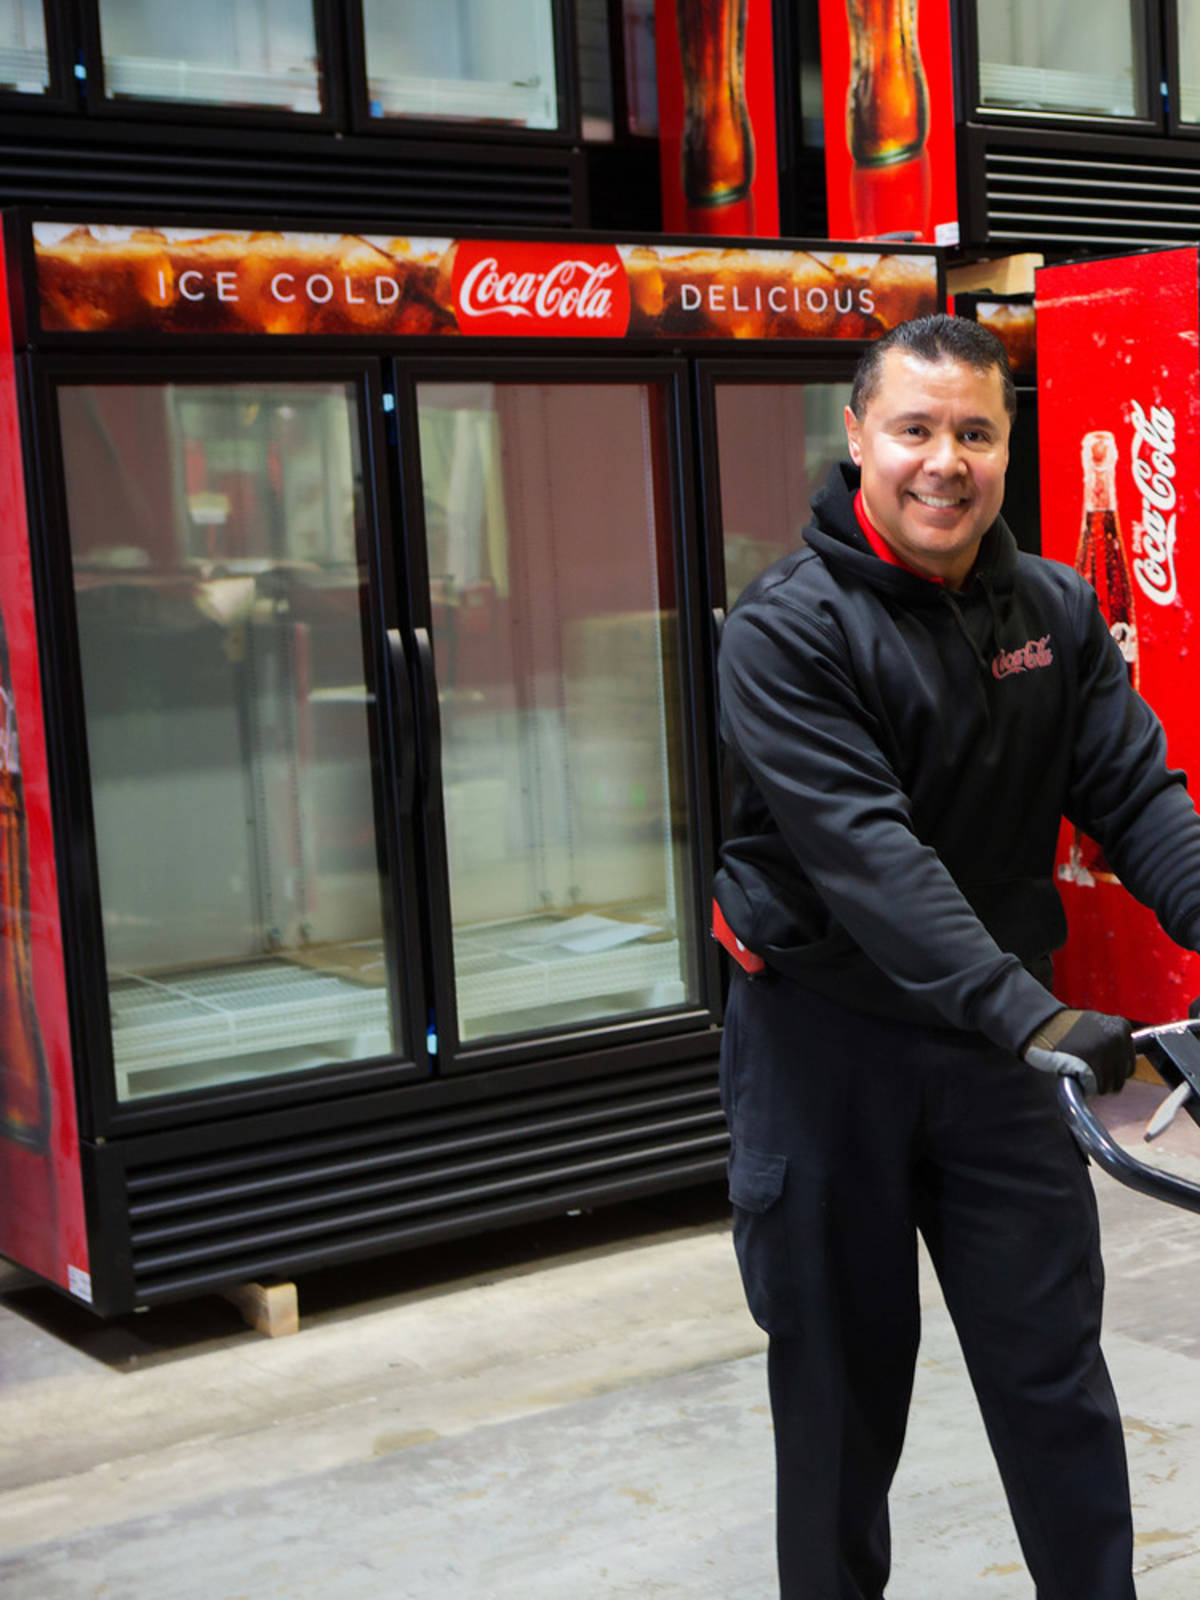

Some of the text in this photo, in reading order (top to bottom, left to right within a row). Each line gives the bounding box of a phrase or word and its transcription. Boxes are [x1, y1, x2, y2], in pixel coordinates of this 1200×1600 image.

[158, 270, 400, 304] ICE COLD
[459, 257, 619, 318] Coca-Cola
[680, 284, 875, 315] DELICIOUS
[1131, 399, 1177, 606] Coca-Cola
